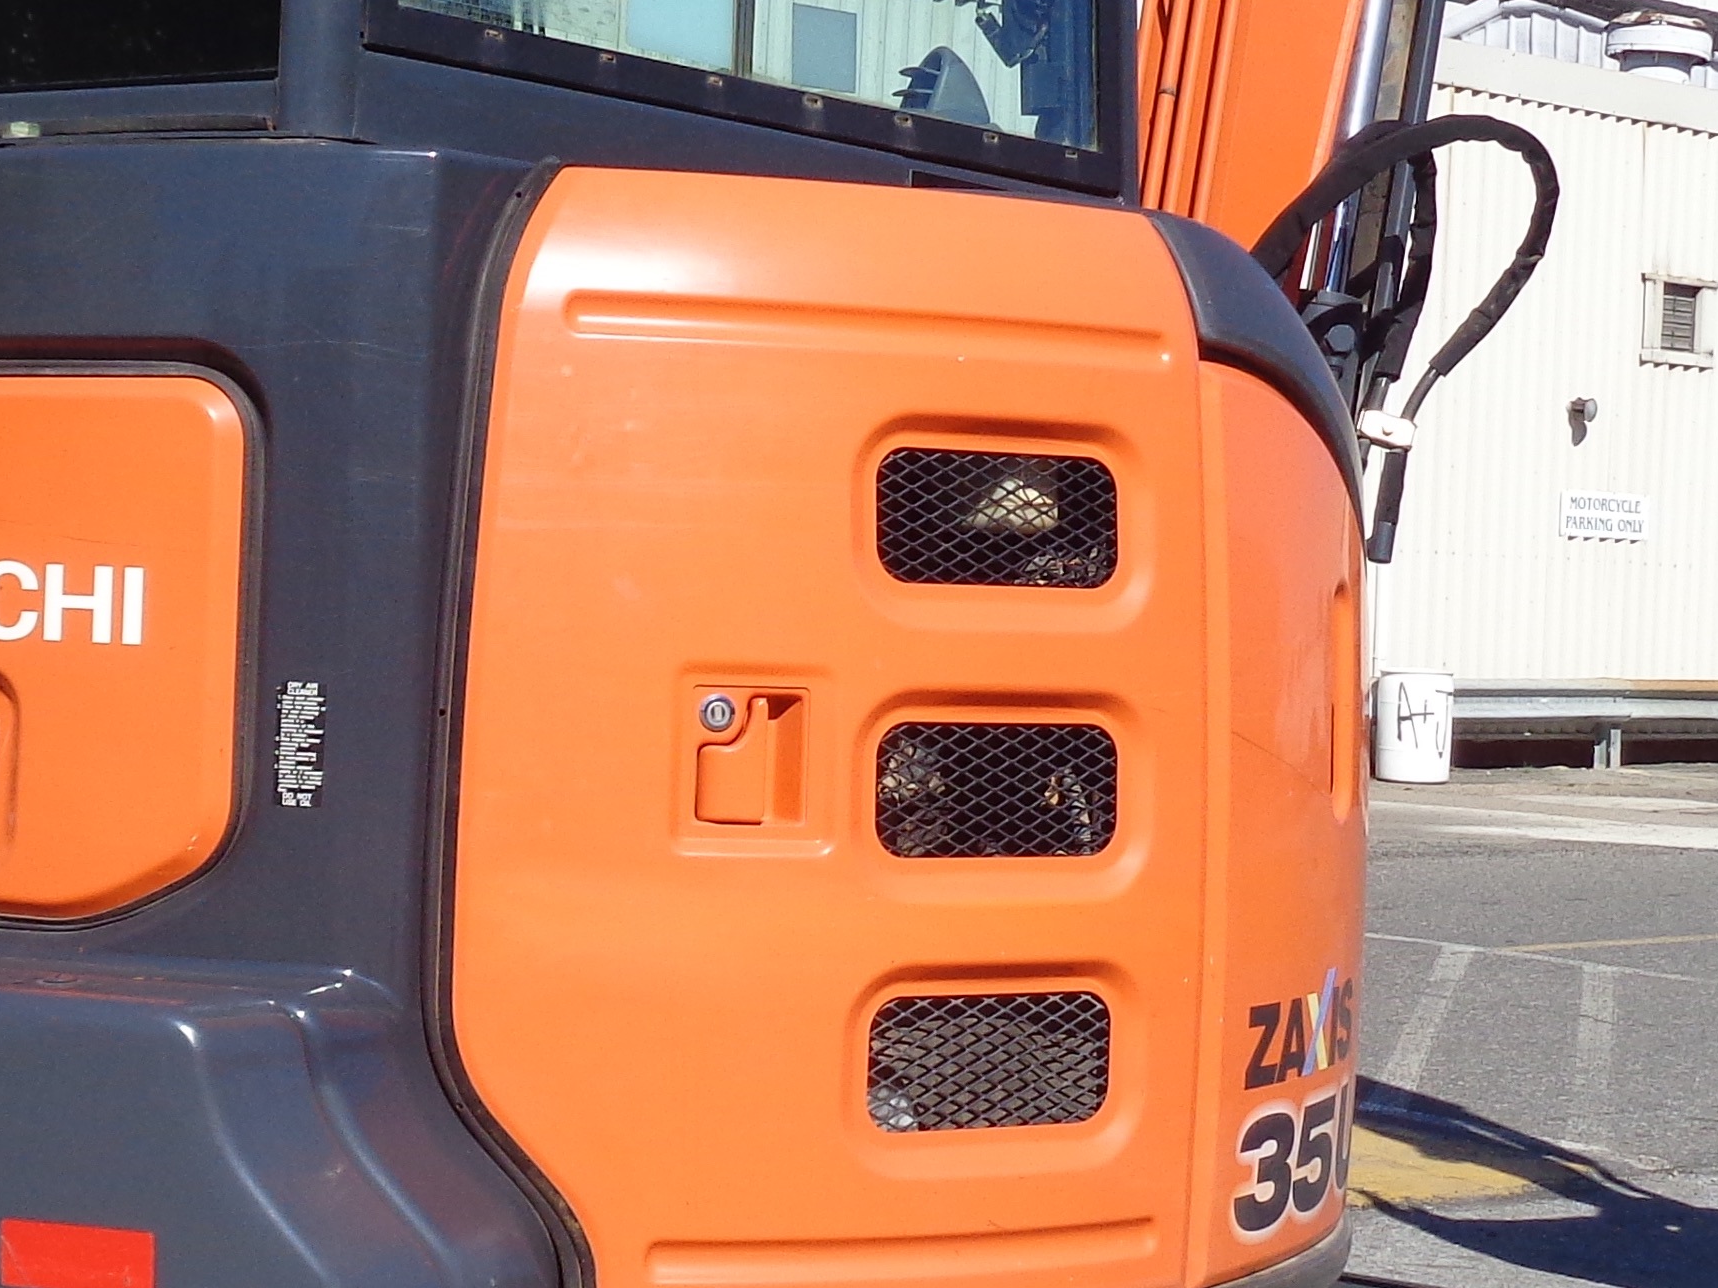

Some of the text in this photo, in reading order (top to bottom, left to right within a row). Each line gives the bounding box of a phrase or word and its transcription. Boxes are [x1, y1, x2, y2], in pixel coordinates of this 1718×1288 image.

[1570, 497, 1641, 513] MOTORCYCLE
[1566, 516, 1644, 533] PARKING ONLY
[1244, 967, 1353, 1090] ZAXIS
